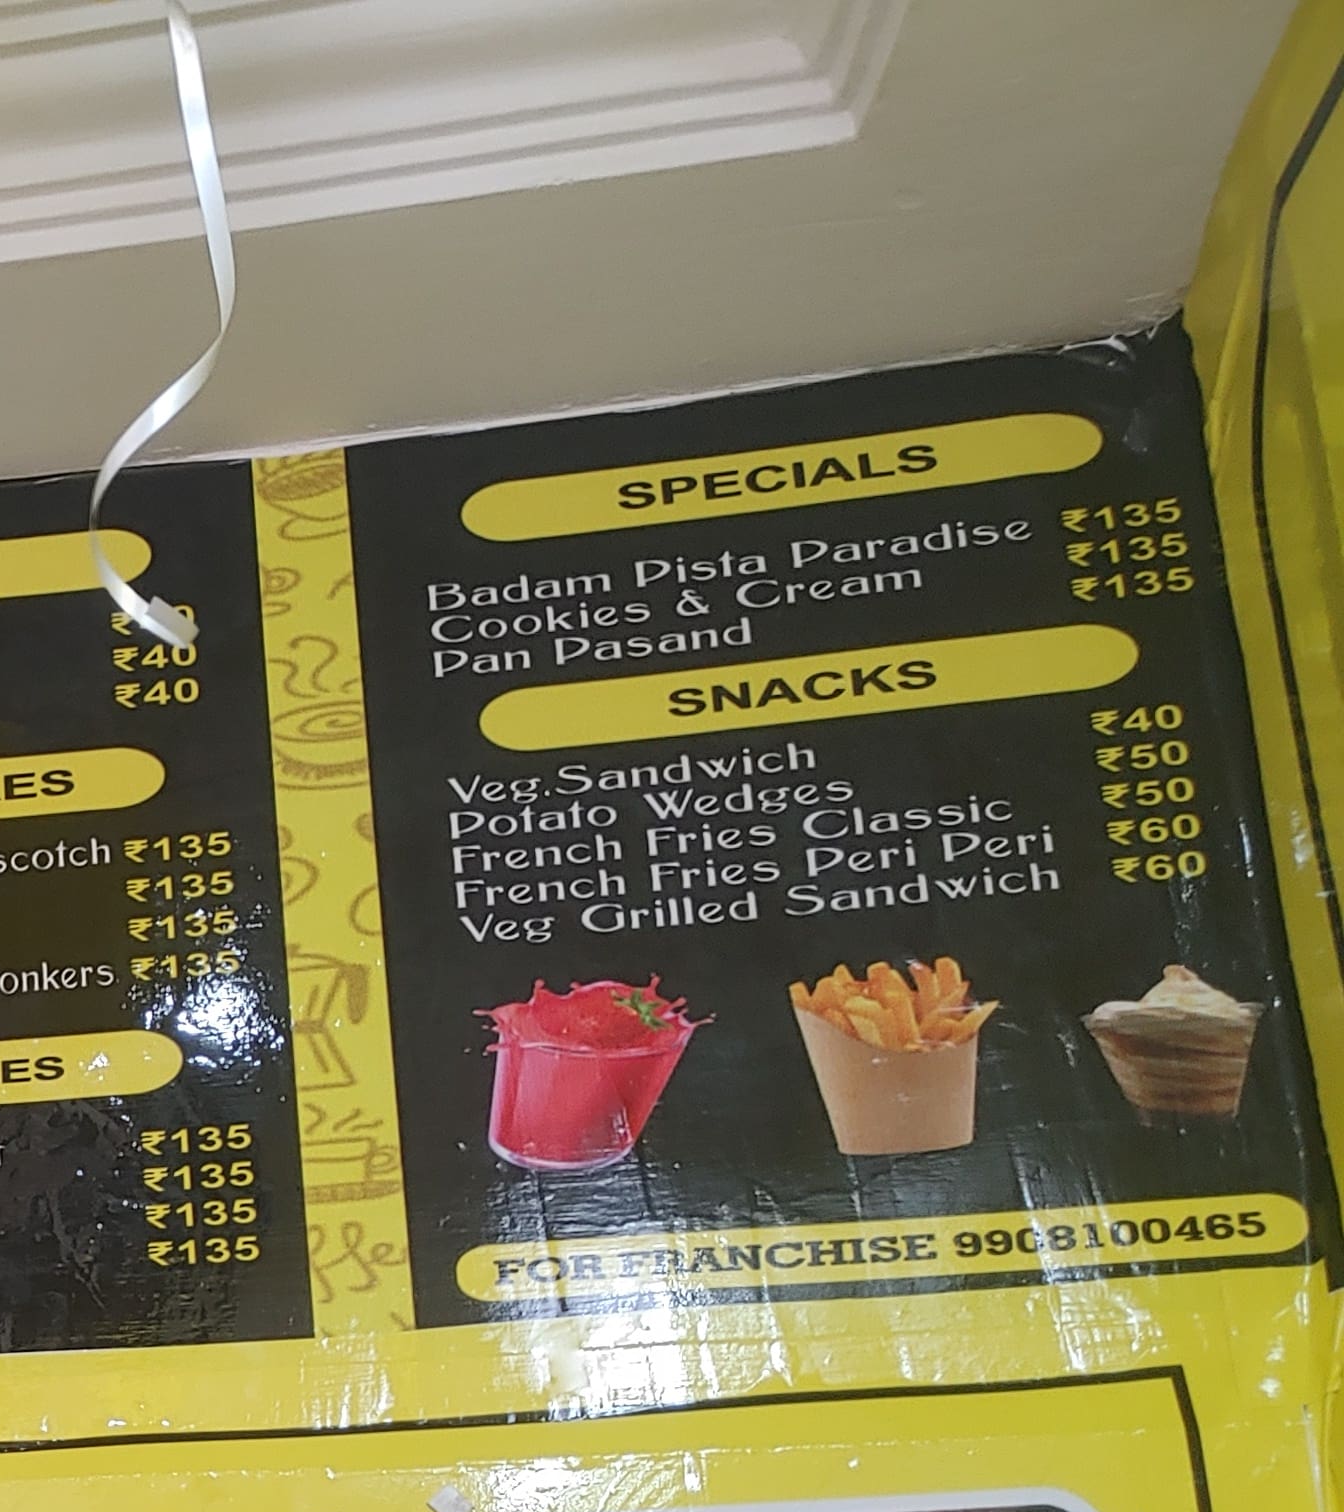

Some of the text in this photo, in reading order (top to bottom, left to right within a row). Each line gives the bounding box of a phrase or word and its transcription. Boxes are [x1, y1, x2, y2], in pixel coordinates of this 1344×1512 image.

[619, 445, 937, 509] SPECIALS
[428, 498, 1180, 611] Badam Pista Paradise ₹135
[432, 570, 921, 642] Cookies & Cream
[434, 617, 751, 677] Pan Pasand
[115, 679, 198, 707] ₹40
[669, 661, 936, 716] SNACKS
[1091, 705, 1182, 735] ₹40
[450, 773, 853, 839] Potato Wedges
[453, 796, 1011, 873] French Fries Classic
[125, 832, 230, 862] ₹135
[456, 825, 1053, 908] French Fries Peri Peri
[460, 852, 1205, 942] Veg Grilled Sandwich ₹60
[493, 1212, 1266, 1285] FOR FRANCHISE 9908100465
